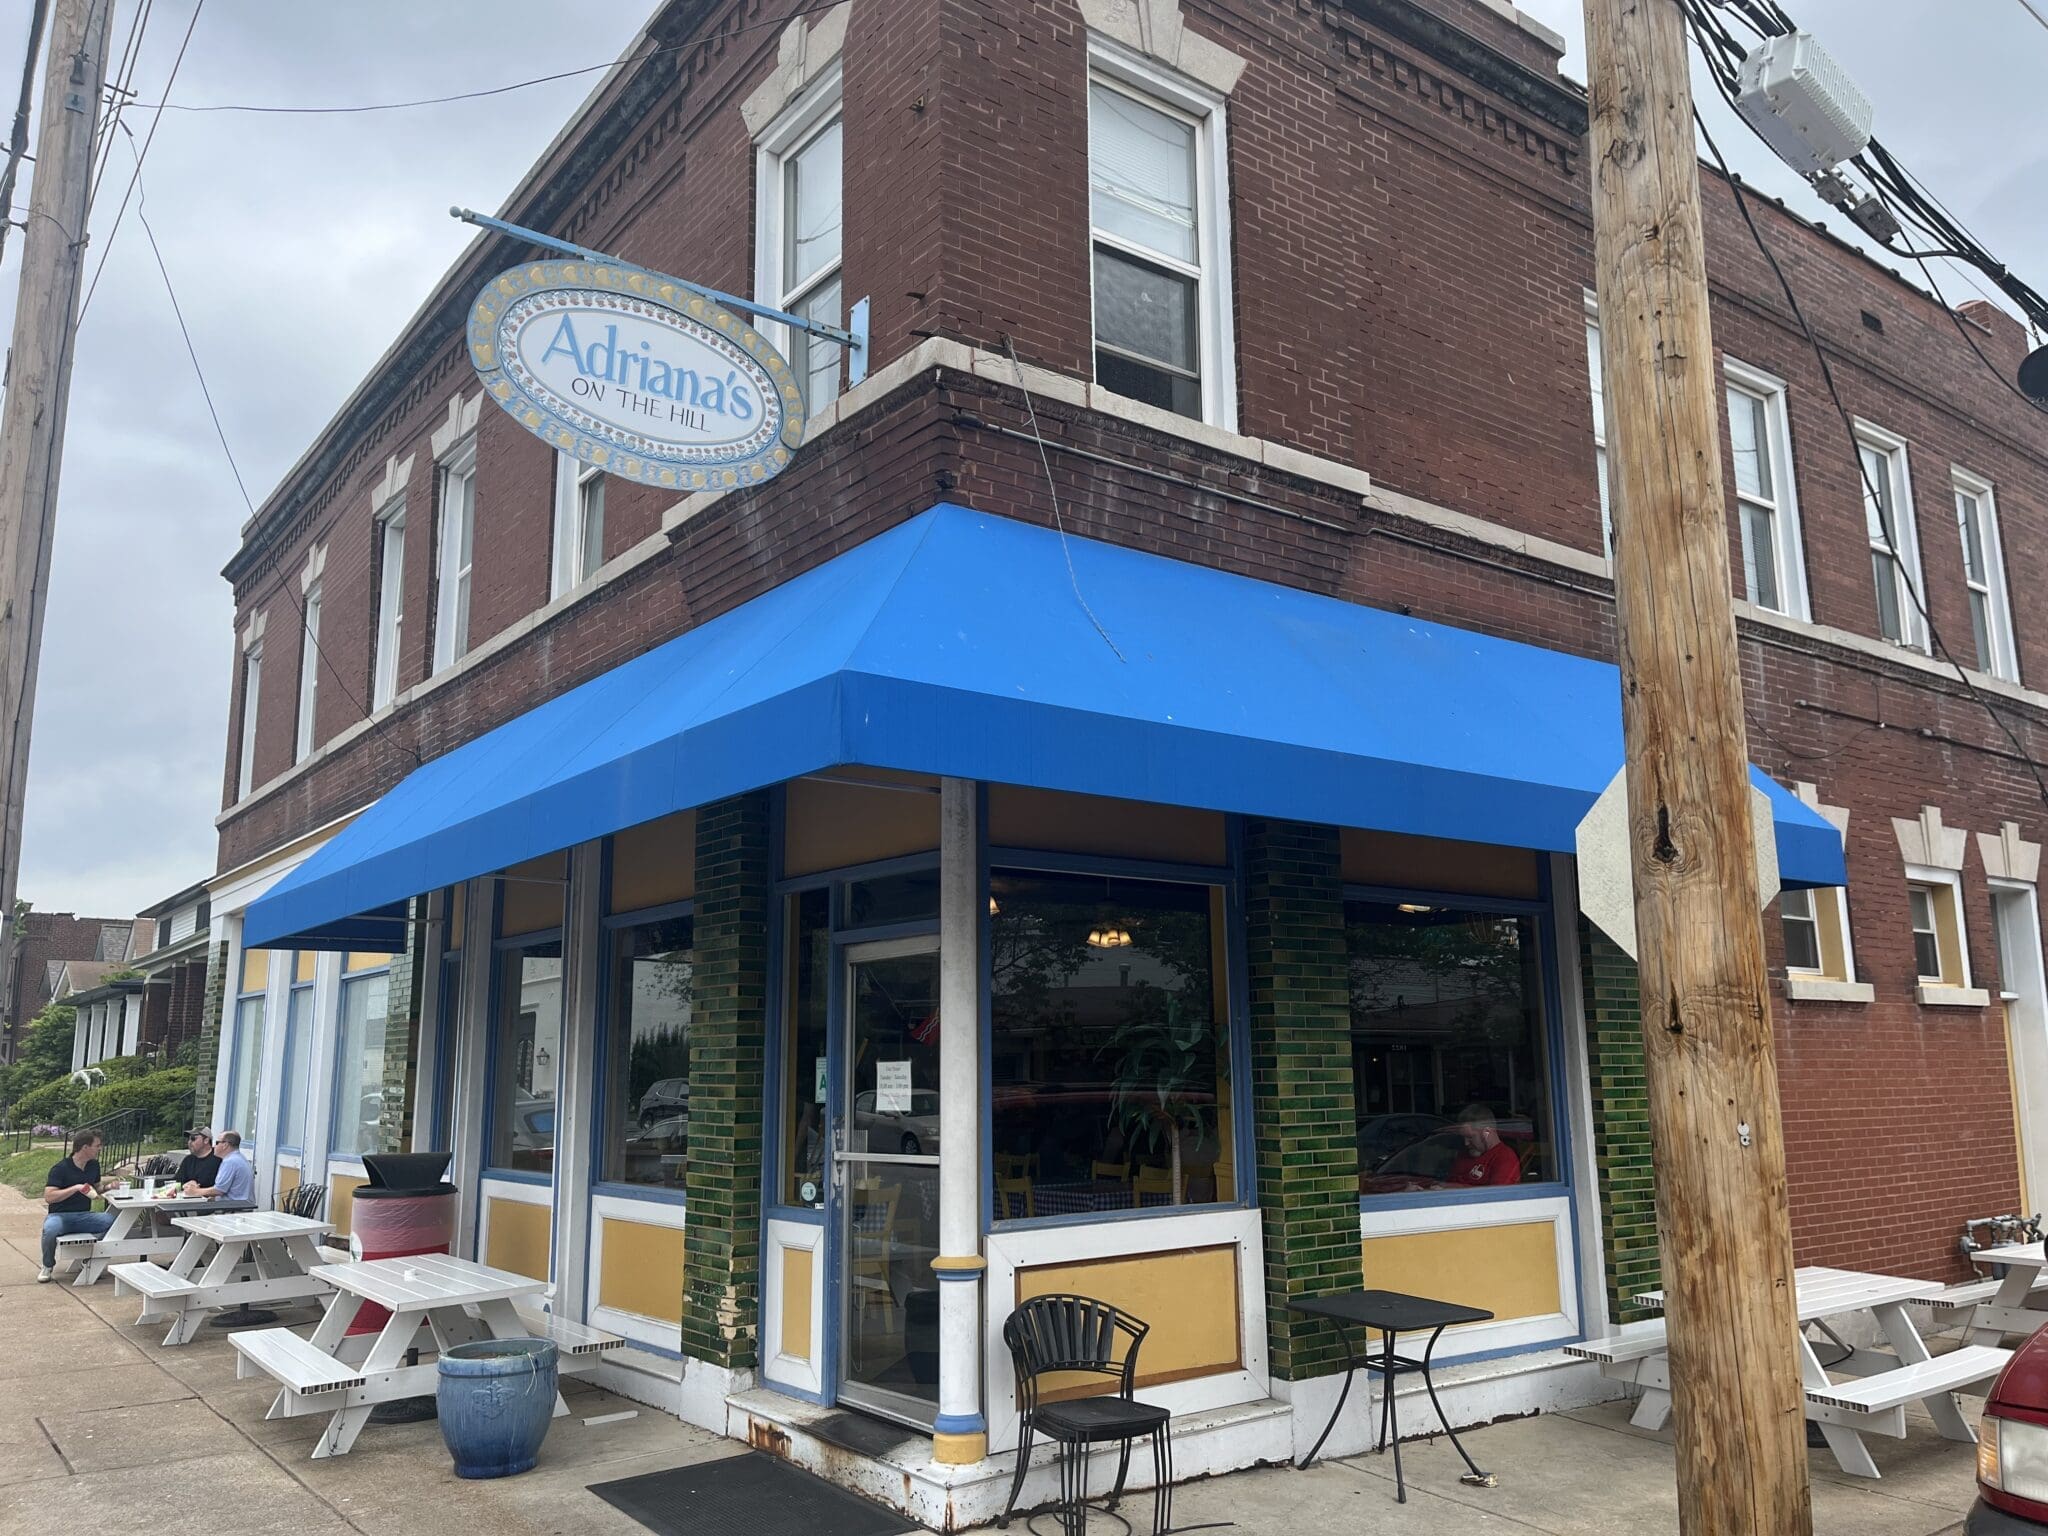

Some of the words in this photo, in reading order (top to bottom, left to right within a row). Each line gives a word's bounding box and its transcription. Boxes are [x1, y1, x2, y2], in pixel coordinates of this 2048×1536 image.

[541, 312, 754, 420] Adriana's
[571, 378, 605, 402] ON
[616, 389, 663, 418] THE
[670, 404, 711, 432] HILL
